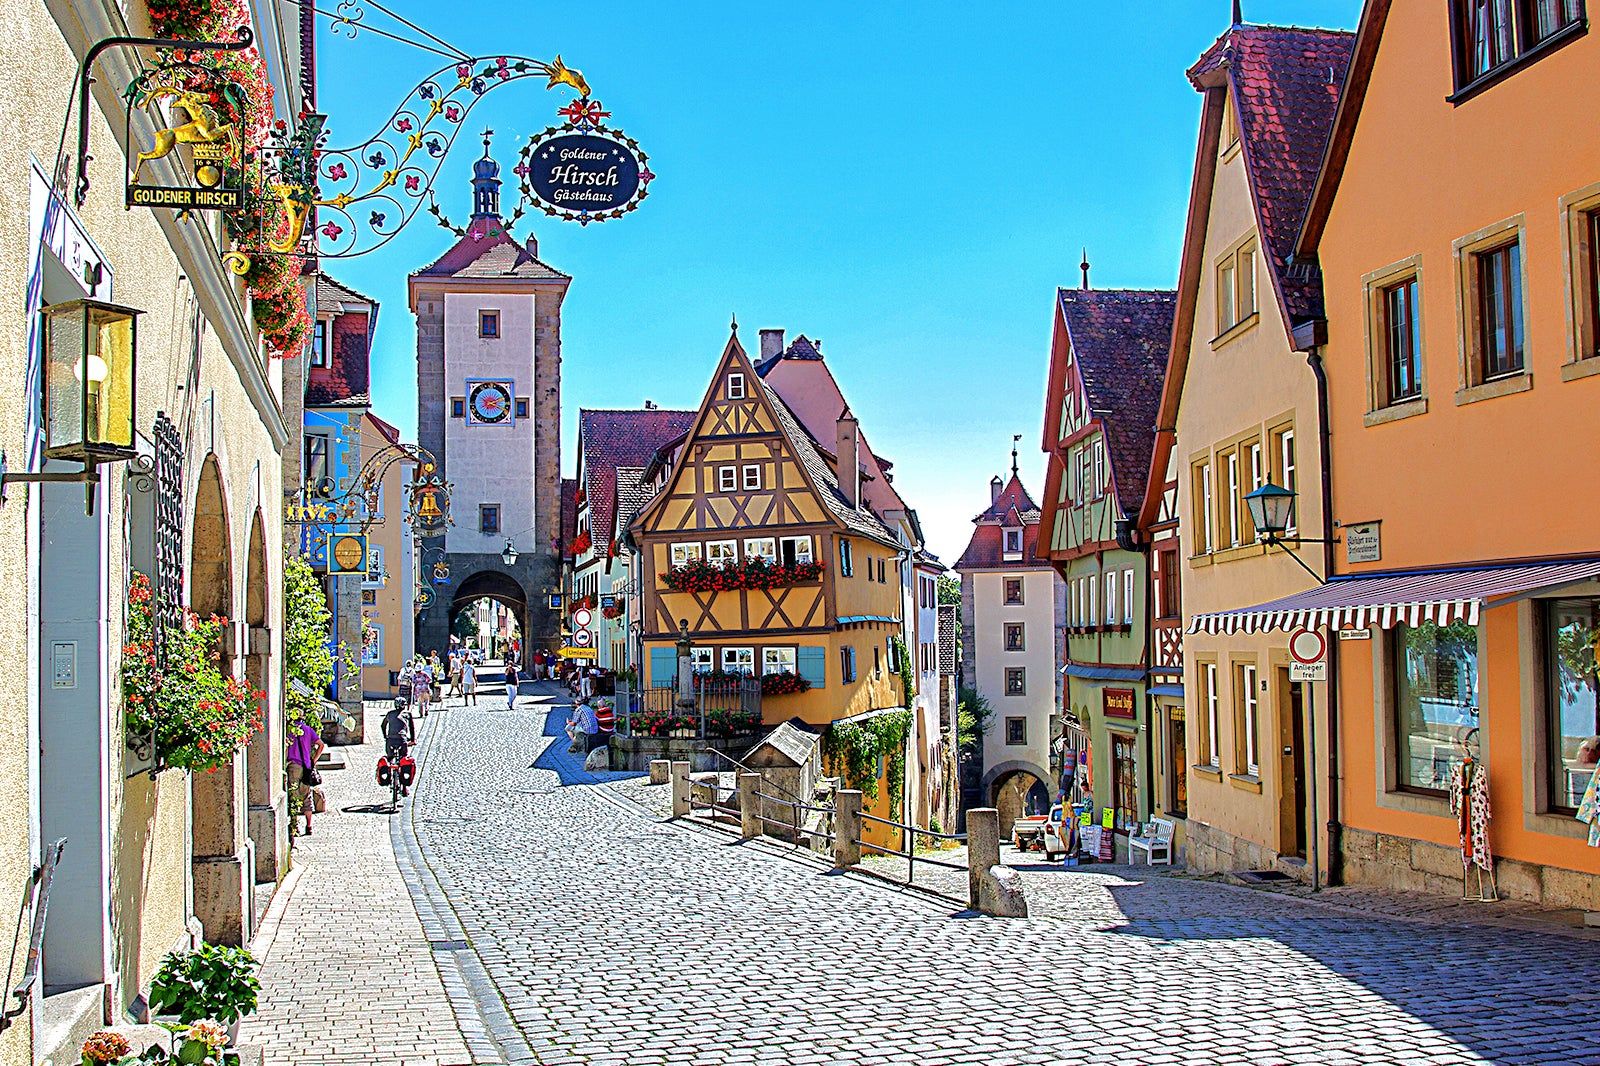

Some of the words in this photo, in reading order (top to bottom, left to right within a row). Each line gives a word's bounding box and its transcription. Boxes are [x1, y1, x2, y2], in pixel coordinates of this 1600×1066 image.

[559, 148, 607, 161] Goldener
[548, 164, 619, 186] Hirsch
[133, 189, 191, 204] GOLDENER
[196, 191, 237, 206] HIRSCH
[553, 189, 613, 203] Gästehaus
[568, 649, 596, 657] Umleitung
[1294, 664, 1323, 672] Anlieger
